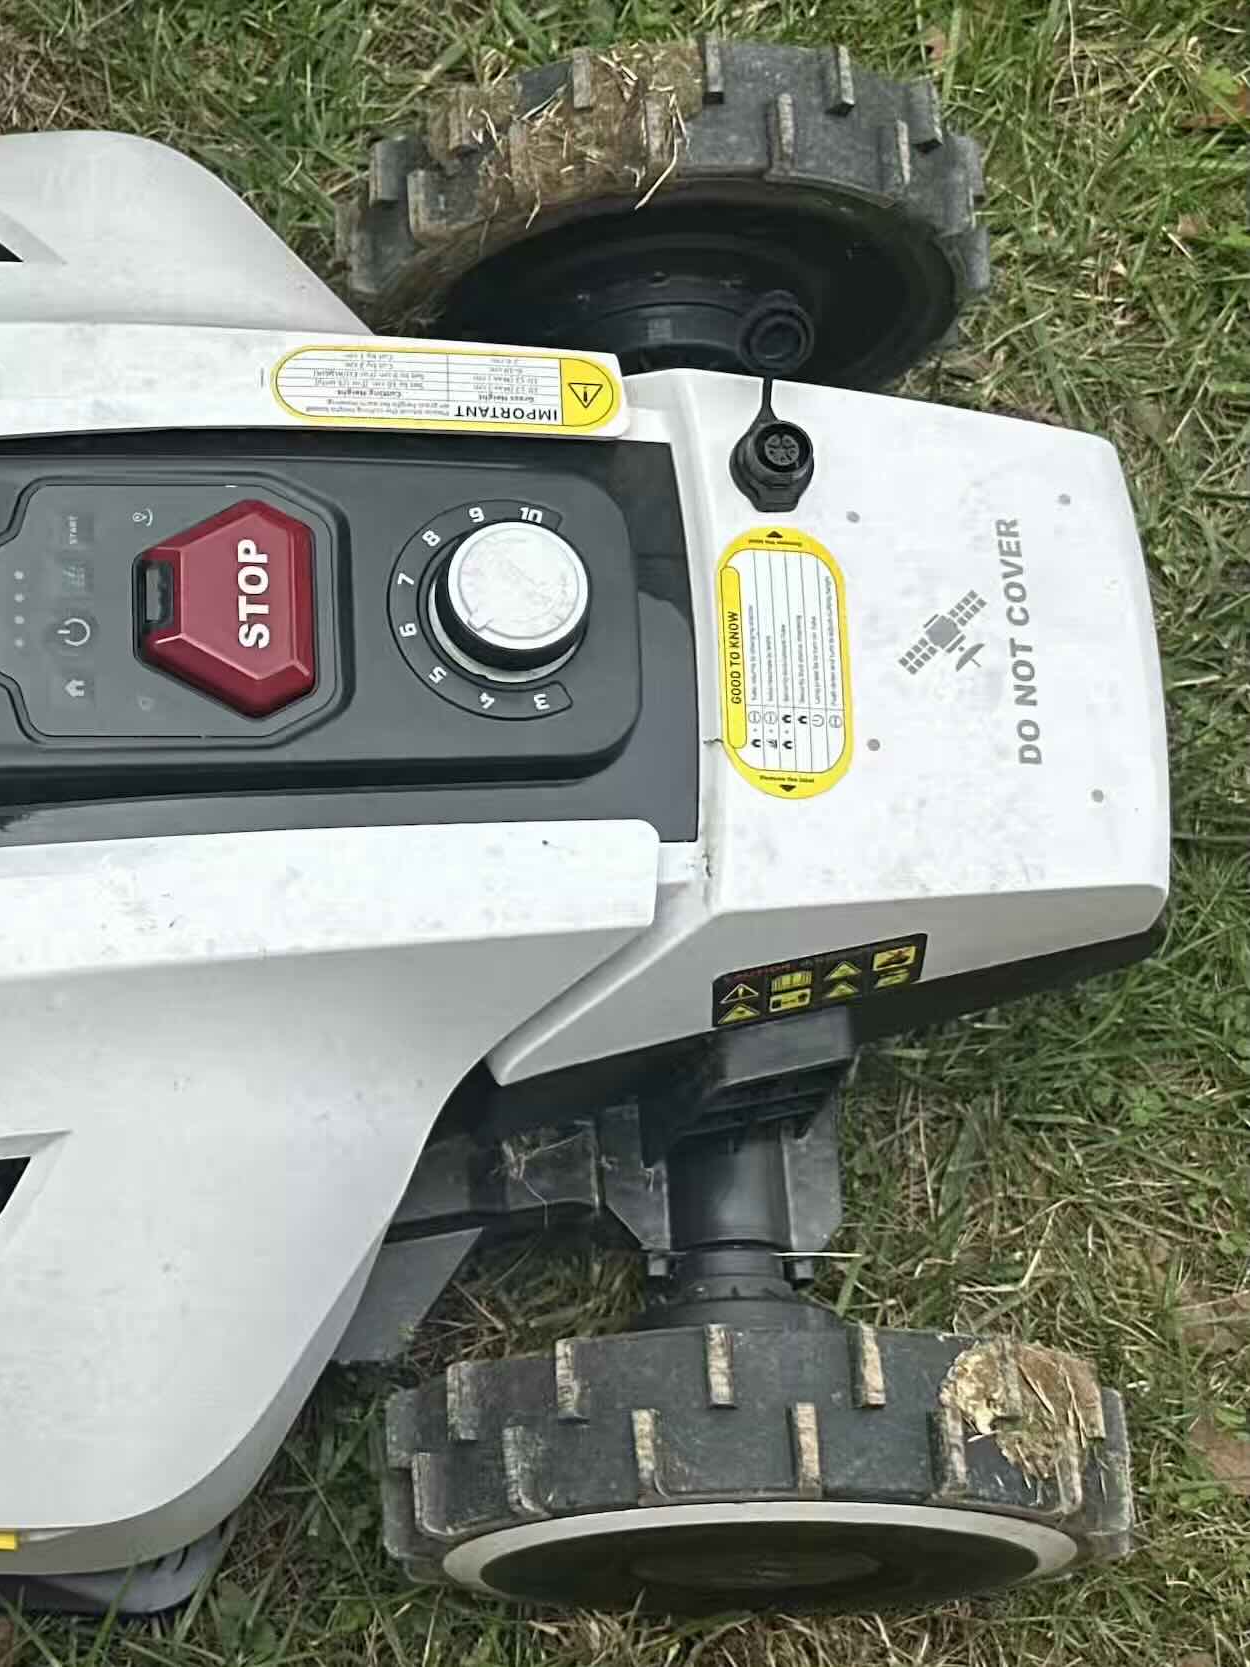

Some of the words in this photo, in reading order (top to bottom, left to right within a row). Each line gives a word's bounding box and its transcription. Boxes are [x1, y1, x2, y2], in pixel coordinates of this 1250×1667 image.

[453, 404, 557, 420] IMPORTANT
[468, 507, 485, 523] 9
[519, 507, 543, 523] 10
[68, 515, 78, 545] START
[422, 530, 441, 547] 8
[397, 573, 415, 586] 7
[994, 518, 1030, 626] COVER
[237, 537, 270, 650] STOP
[399, 622, 417, 638] 6
[728, 611, 740, 648] KNOW
[729, 652, 741, 666] TO
[428, 666, 447, 684] 5
[1009, 637, 1038, 706] NOT
[729, 671, 742, 704] GOOD
[478, 692, 495, 709] 4
[533, 693, 550, 710] 3
[1016, 719, 1042, 765] DO
